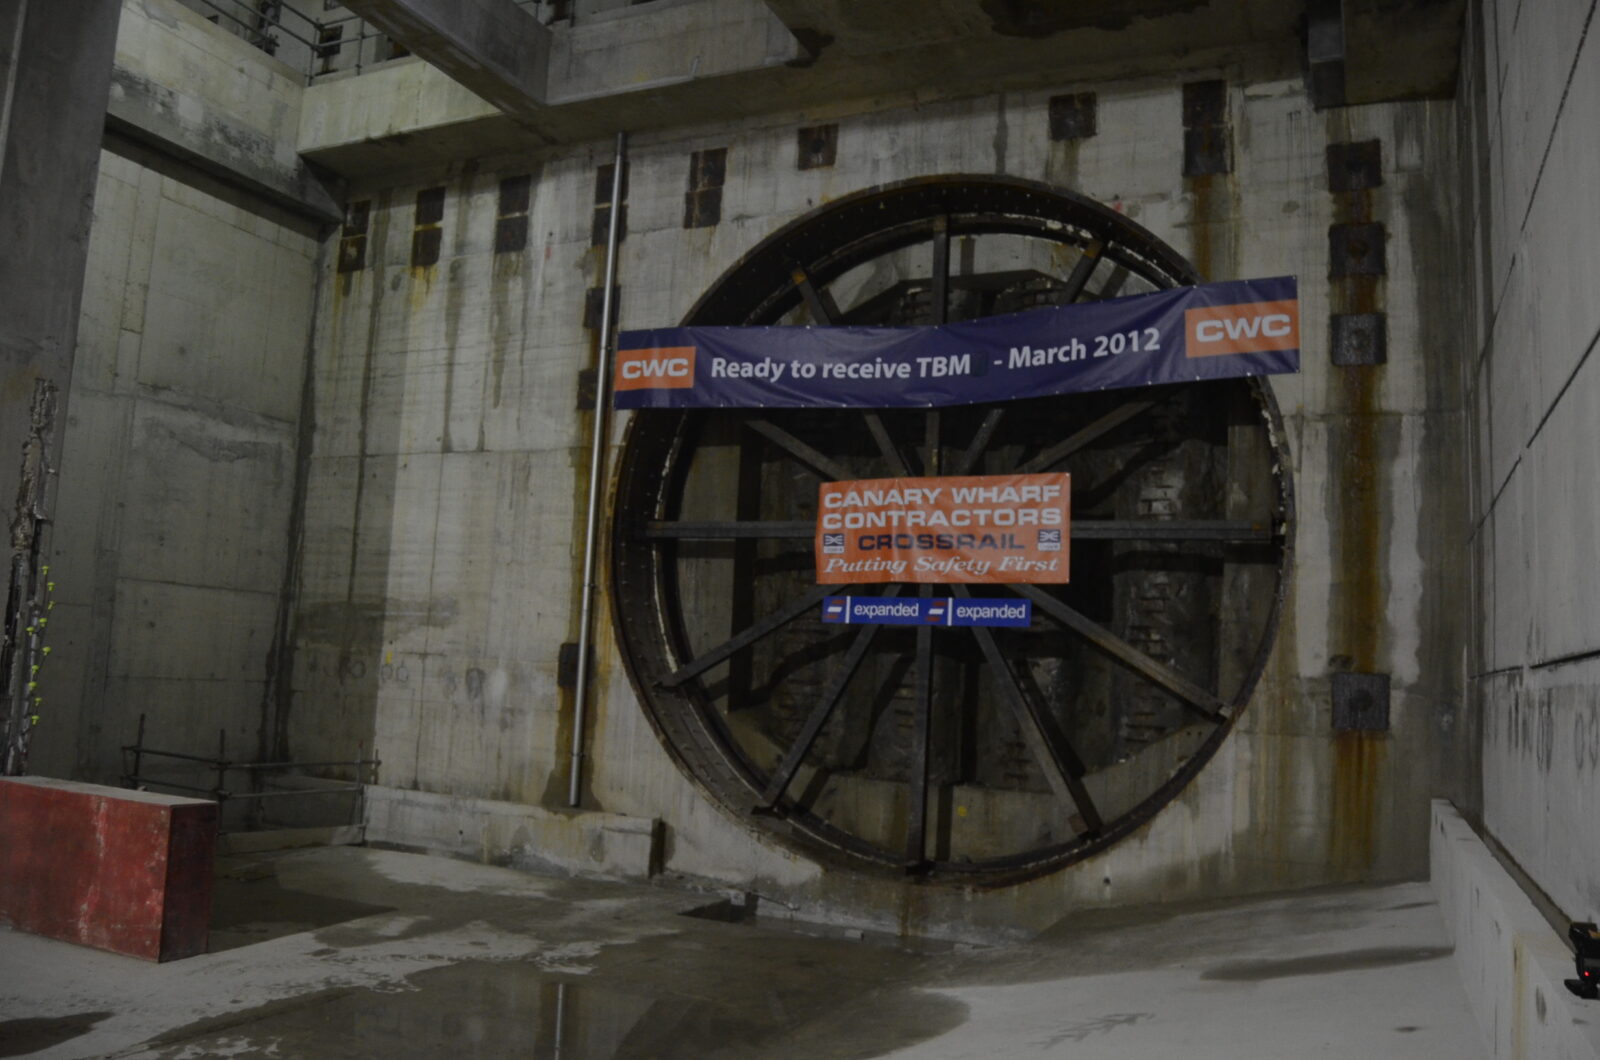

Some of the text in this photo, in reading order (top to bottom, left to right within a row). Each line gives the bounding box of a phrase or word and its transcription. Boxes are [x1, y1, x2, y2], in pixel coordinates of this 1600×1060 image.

[1195, 313, 1291, 343] CWC
[711, 357, 786, 383] Ready
[791, 358, 817, 379] to
[822, 357, 911, 379] receive
[916, 354, 971, 378] TBM
[1008, 338, 1087, 370] March
[1093, 327, 1161, 357] 2012
[622, 358, 689, 379] CWC
[824, 484, 1061, 508] CANARY WHARF
[822, 508, 1062, 529] CONTRACTORS
[858, 533, 1026, 551] CROSSRAIL
[823, 555, 1059, 575] Putting Safety First
[854, 602, 919, 618] expanded
[956, 604, 1026, 620] expanded
